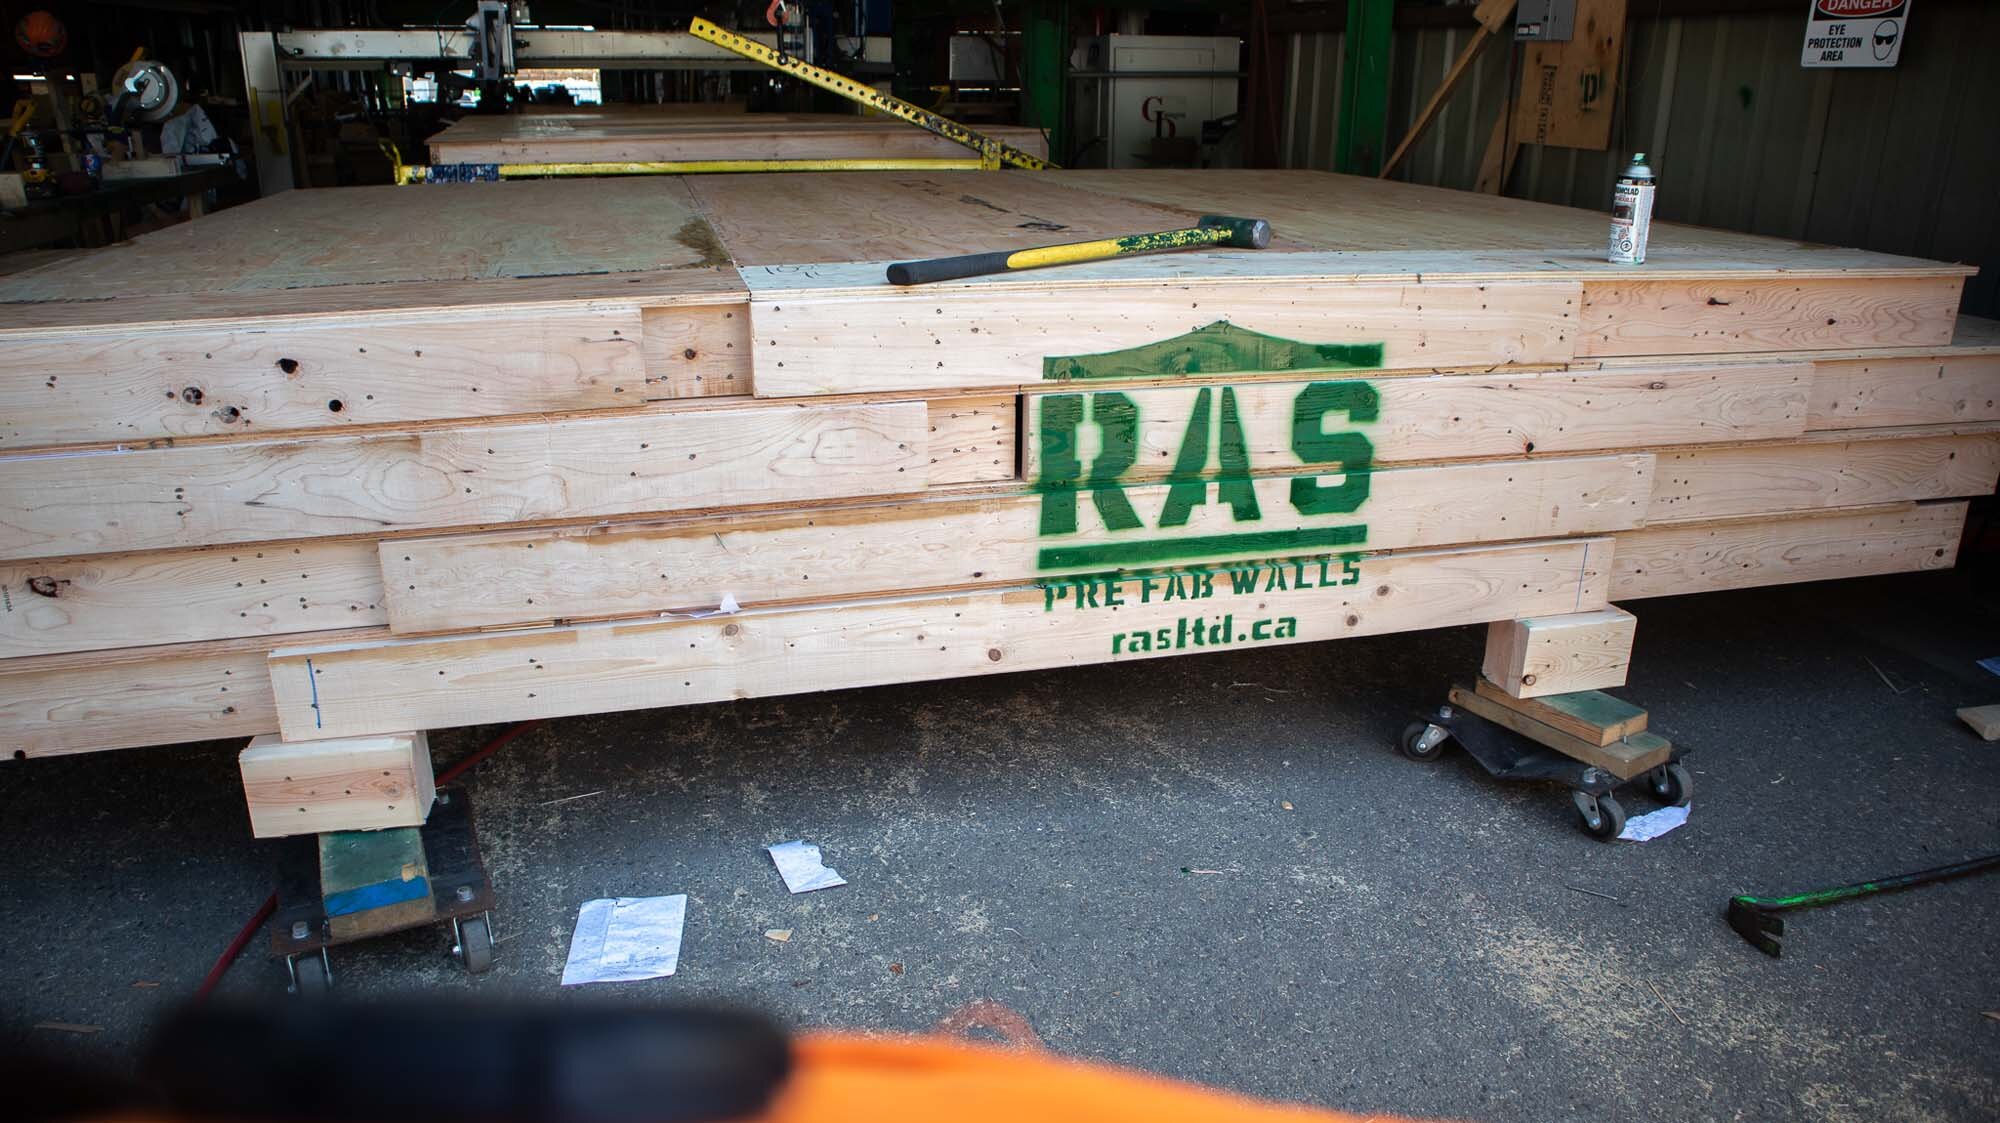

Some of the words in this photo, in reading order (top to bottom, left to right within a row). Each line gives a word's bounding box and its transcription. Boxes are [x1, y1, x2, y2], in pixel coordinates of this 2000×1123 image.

[1808, 37, 1863, 48] PROTECTION
[1829, 24, 1846, 35] EYE
[1820, 51, 1843, 61] AREA
[1039, 381, 1379, 535] RAS
[1045, 578, 1125, 611] PRE
[1141, 570, 1214, 603] FAB
[1231, 555, 1361, 595] WALLS
[1112, 614, 1297, 655] rasltd.ca
